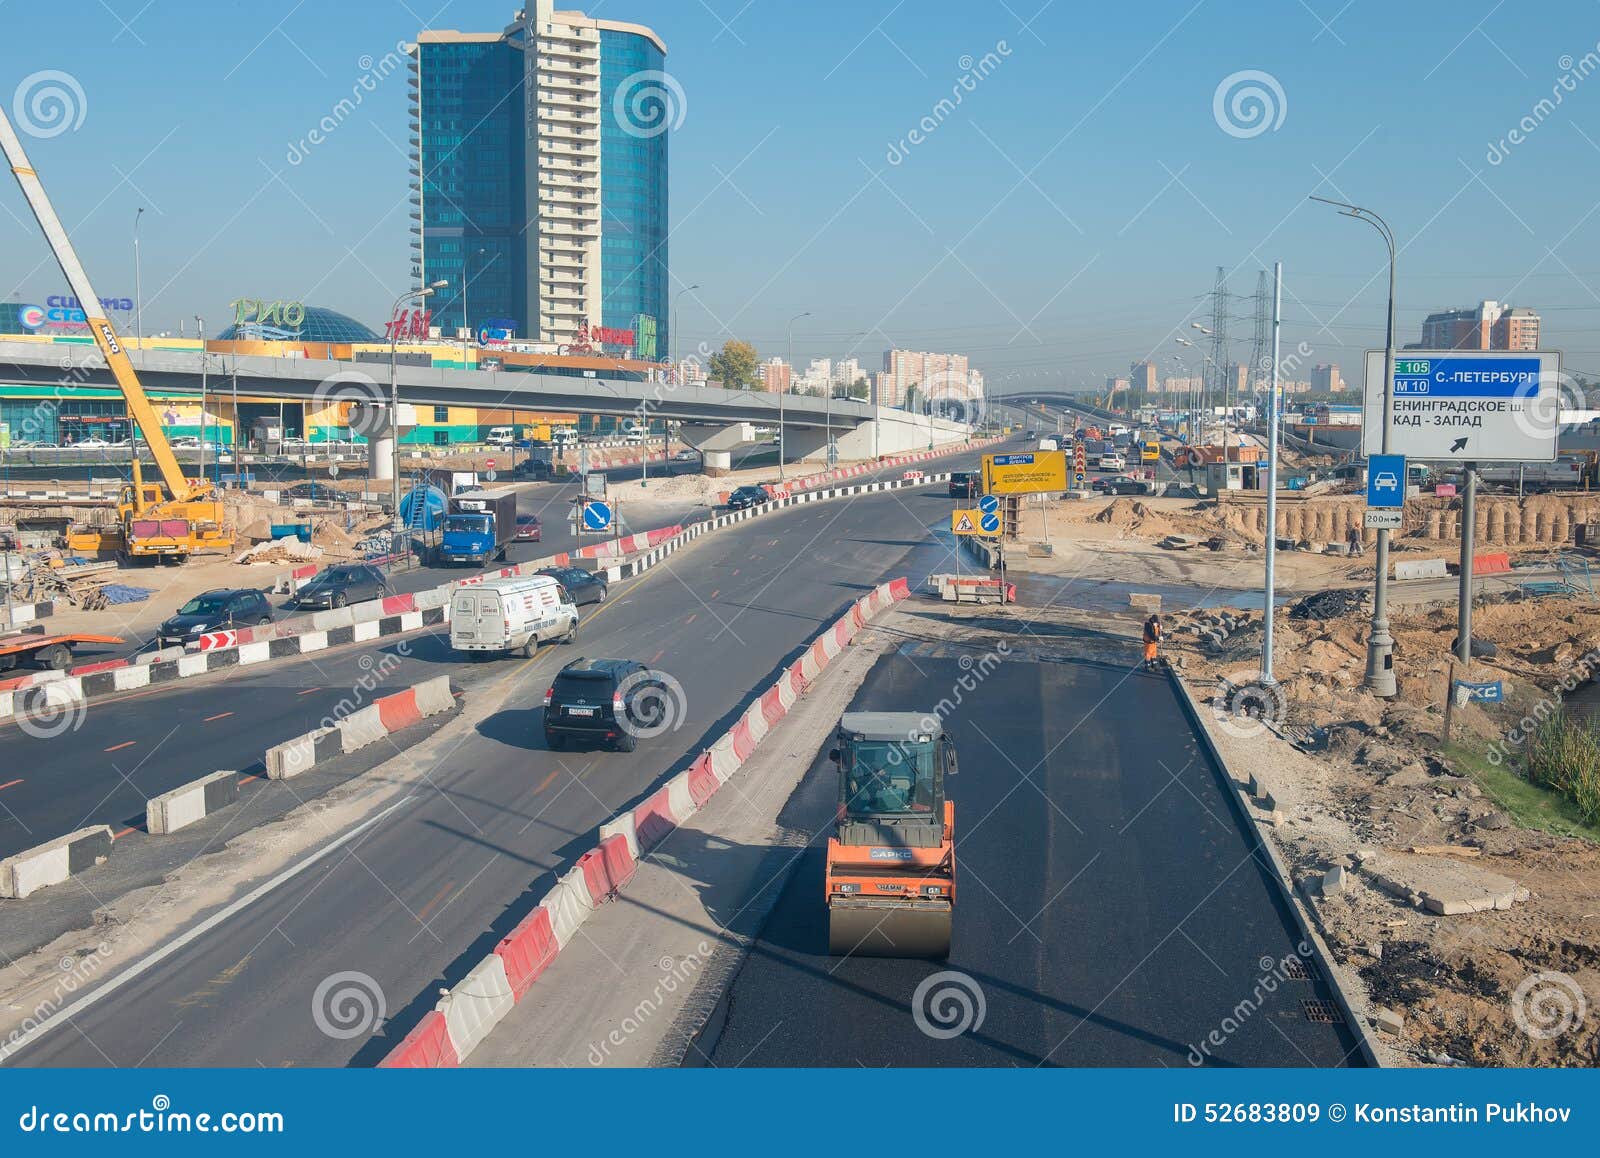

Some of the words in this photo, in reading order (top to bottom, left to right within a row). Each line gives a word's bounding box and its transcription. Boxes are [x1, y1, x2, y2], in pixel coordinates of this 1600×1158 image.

[47, 307, 87, 323] ста
[384, 308, 432, 341] H&M
[101, 324, 120, 355] KATO
[1406, 362, 1428, 373] 105
[1435, 371, 1536, 383] С.-ПЕТЕРБУРГ
[1412, 380, 1427, 392] 10
[1393, 400, 1506, 413] ЕНИНГРАДСКОЕ
[1393, 415, 1421, 427] КАД
[1433, 415, 1482, 428] ЗАПАД
